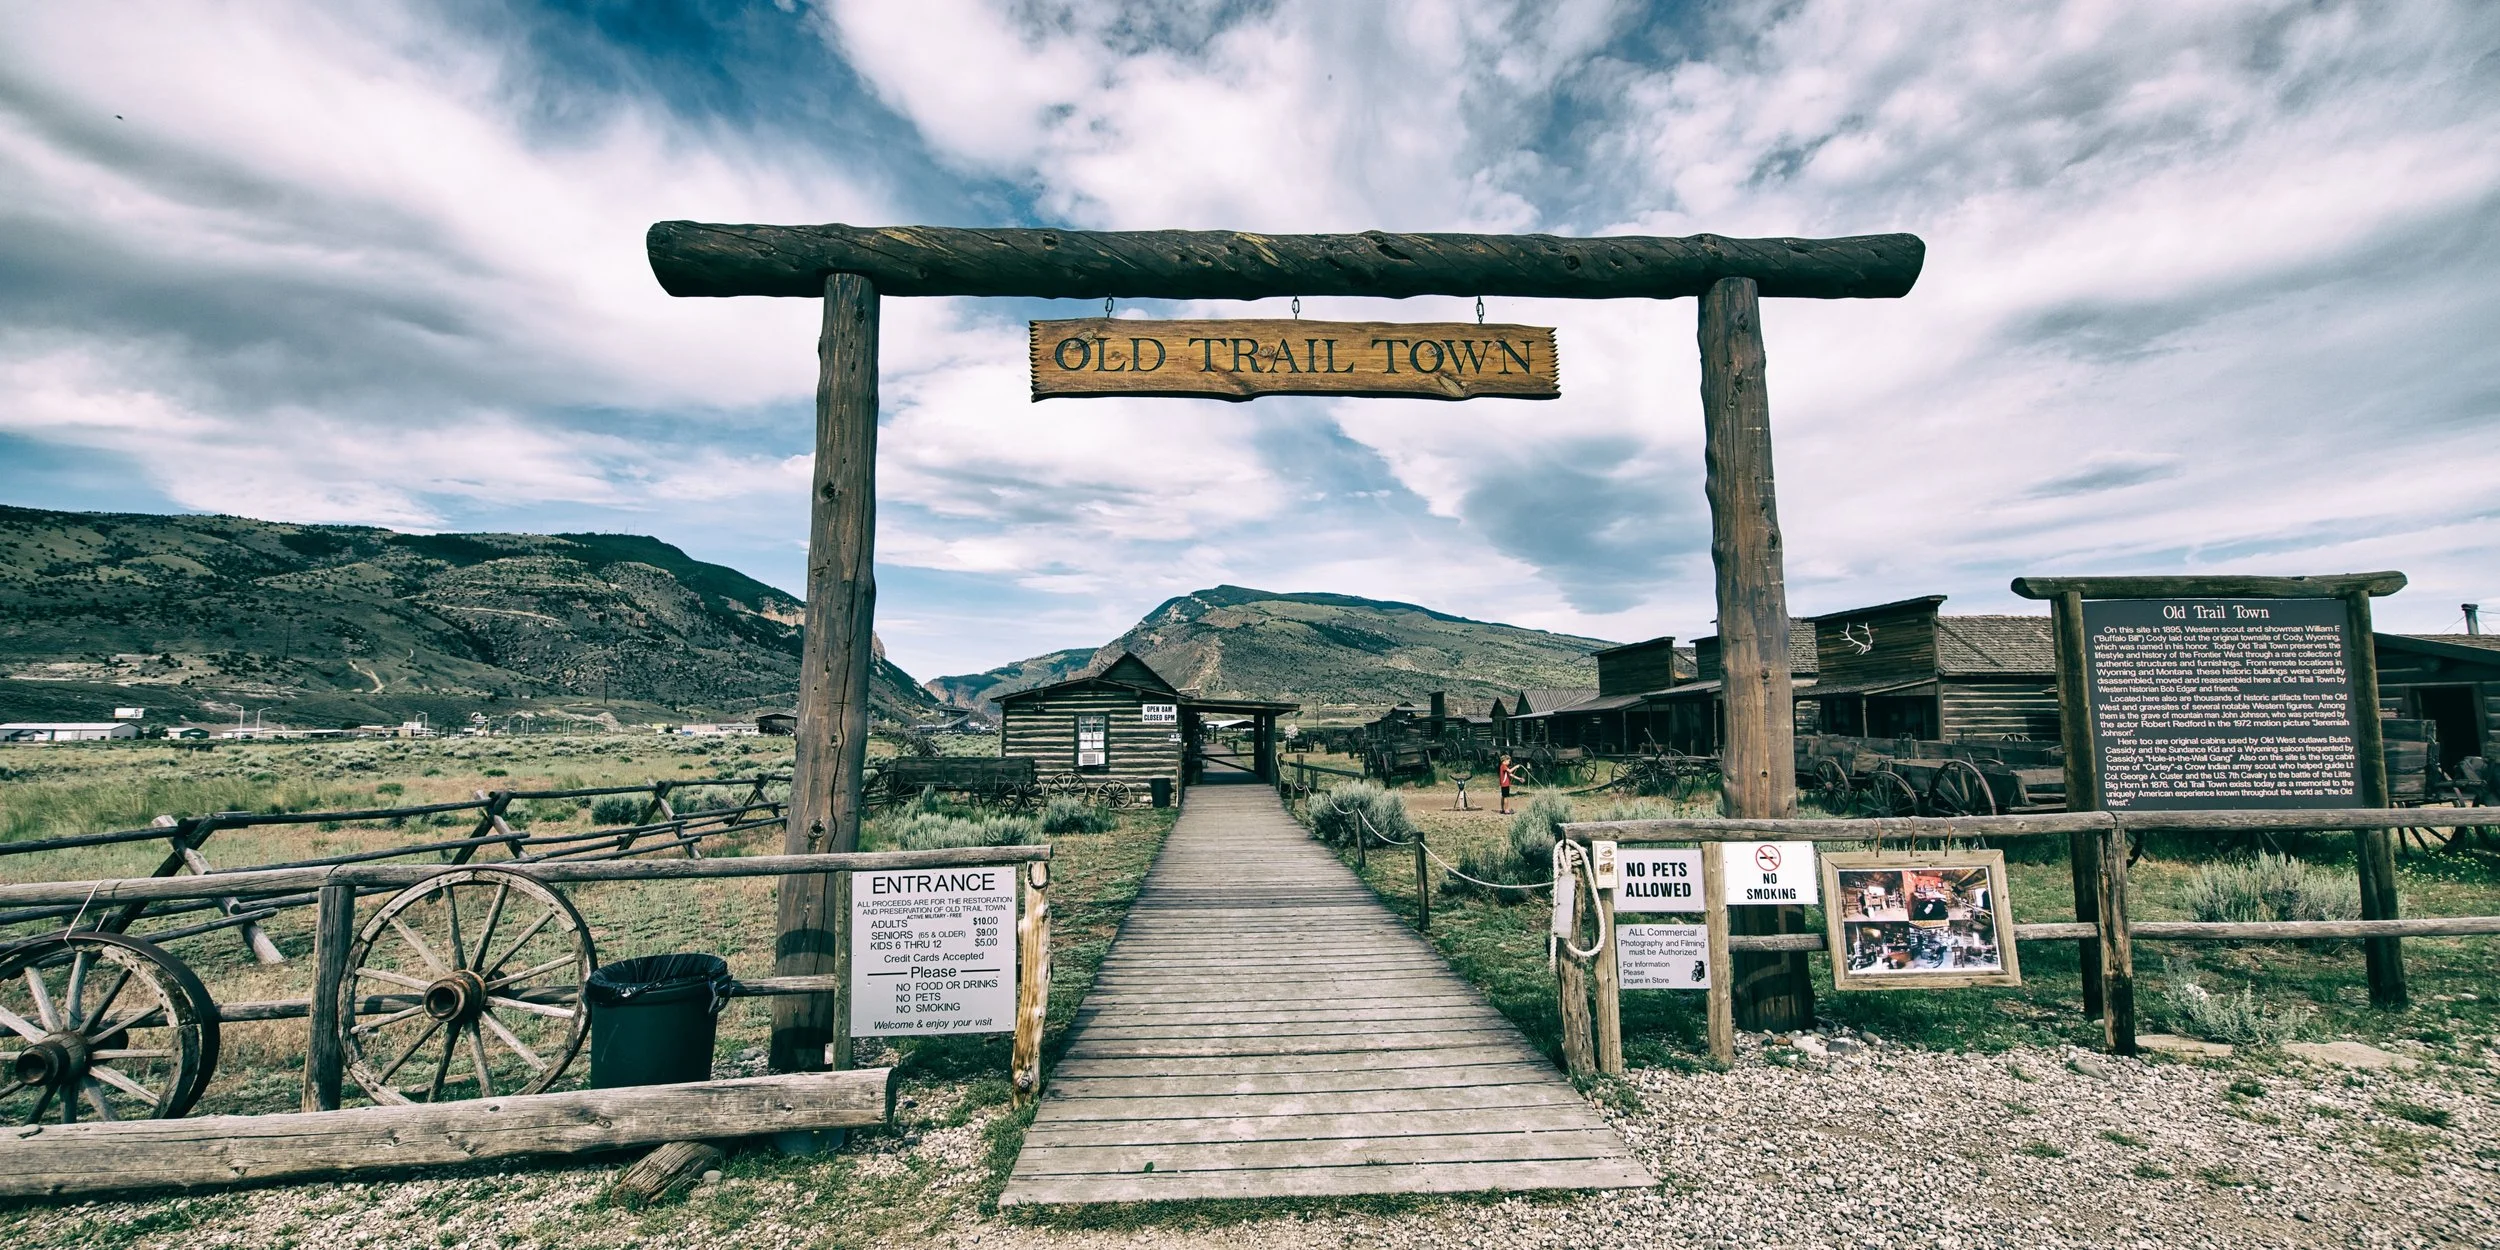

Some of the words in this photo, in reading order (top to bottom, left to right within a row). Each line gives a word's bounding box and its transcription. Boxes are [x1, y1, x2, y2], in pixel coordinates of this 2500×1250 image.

[1055, 338, 1166, 372] OLD
[1189, 338, 1354, 373] TRAIL
[1372, 339, 1534, 374] TOWN
[2163, 605, 2186, 619] Old
[2193, 605, 2226, 619] Trail
[2232, 605, 2270, 619] Town
[2095, 660, 2134, 668] authentic
[2245, 659, 2268, 667] From
[2268, 659, 2297, 667] remote
[2096, 668, 2137, 677] Wyoming
[2138, 668, 2155, 676] and
[2155, 668, 2193, 676] Montana
[2253, 667, 2288, 676] buildings
[2312, 667, 2346, 676] carefully
[2184, 676, 2200, 684] and
[2201, 676, 2252, 684] reassembled
[2253, 676, 2272, 684] here
[2282, 675, 2297, 683] Old
[2298, 675, 2314, 683] Trail
[2315, 675, 2336, 683] Town
[2336, 676, 2347, 685] by
[2160, 685, 2175, 693] Bob
[2176, 685, 2197, 694] Edgar
[2122, 703, 2138, 711] and
[2138, 704, 2180, 712] gravesites
[2181, 703, 2190, 711] of
[2251, 702, 2285, 710] Western
[2318, 702, 2346, 711] Among
[2140, 720, 2171, 728] Robert
[2172, 720, 2207, 728] Redford
[2233, 719, 2252, 727] 1972
[2282, 719, 2311, 728] picture
[2170, 737, 2199, 746] original
[2199, 737, 2226, 745] cabins
[2248, 737, 2259, 746] by
[2260, 736, 2275, 744] Old
[2275, 736, 2297, 744] West
[2297, 736, 2328, 744] outlaws
[2328, 735, 2351, 743] Butch
[2105, 790, 2136, 799] uniquely
[2174, 789, 2215, 798] experience
[2215, 789, 2240, 797] known
[2241, 789, 2279, 798] throughout
[2280, 788, 2293, 796] the
[2293, 788, 2314, 796] world
[2339, 787, 2353, 795] Old
[1626, 862, 1646, 877] NO
[1652, 862, 1688, 877] PETS
[872, 873, 995, 894] ENTRANCE
[1762, 873, 1777, 884] NO
[1625, 882, 1692, 898] ALLOWED
[1746, 888, 1797, 900] SMOKING
[872, 899, 912, 907] PROCEEDS
[913, 898, 929, 906] ARE
[930, 898, 946, 906] FOR
[947, 897, 961, 905] THE
[962, 896, 1013, 904] RESTORATION
[879, 906, 933, 915] PRESERVATION
[945, 905, 961, 913] OLD
[870, 919, 908, 929] ADULTS
[973, 916, 999, 926] $10.00
[871, 930, 914, 941] SENIORS
[918, 931, 930, 939] (65
[938, 930, 966, 938] OLDER)
[975, 927, 998, 937] $9.00
[1628, 928, 1645, 937] ALL
[1647, 927, 1697, 937] Commercial
[870, 941, 893, 950] KIDS
[895, 941, 902, 950] 6
[904, 940, 930, 949] THRU
[932, 939, 942, 948] 12
[974, 937, 998, 947] $5.00
[1621, 939, 1664, 948] Photography
[1680, 938, 1705, 949] Filming
[1646, 948, 1657, 956] be
[1658, 948, 1698, 956] Authorized
[883, 954, 911, 964] Credit
[913, 953, 940, 962] Cards
[942, 952, 984, 962] Accepted
[910, 966, 957, 979] Please
[895, 982, 911, 992] NO
[915, 981, 944, 991] FOOD
[945, 980, 961, 990] OR
[963, 979, 998, 989] DRINKS
[1623, 977, 1644, 985] Inquire
[1651, 976, 1670, 984] Store
[895, 993, 911, 1003] NO
[915, 992, 941, 1002] PETS
[896, 1004, 911, 1014] NO
[915, 1002, 961, 1013] SMOKING
[874, 1020, 914, 1030] Welcome
[916, 1019, 923, 1029] &
[926, 1019, 950, 1030] enjoy
[952, 1019, 972, 1029] your
[974, 1018, 992, 1026] visit
